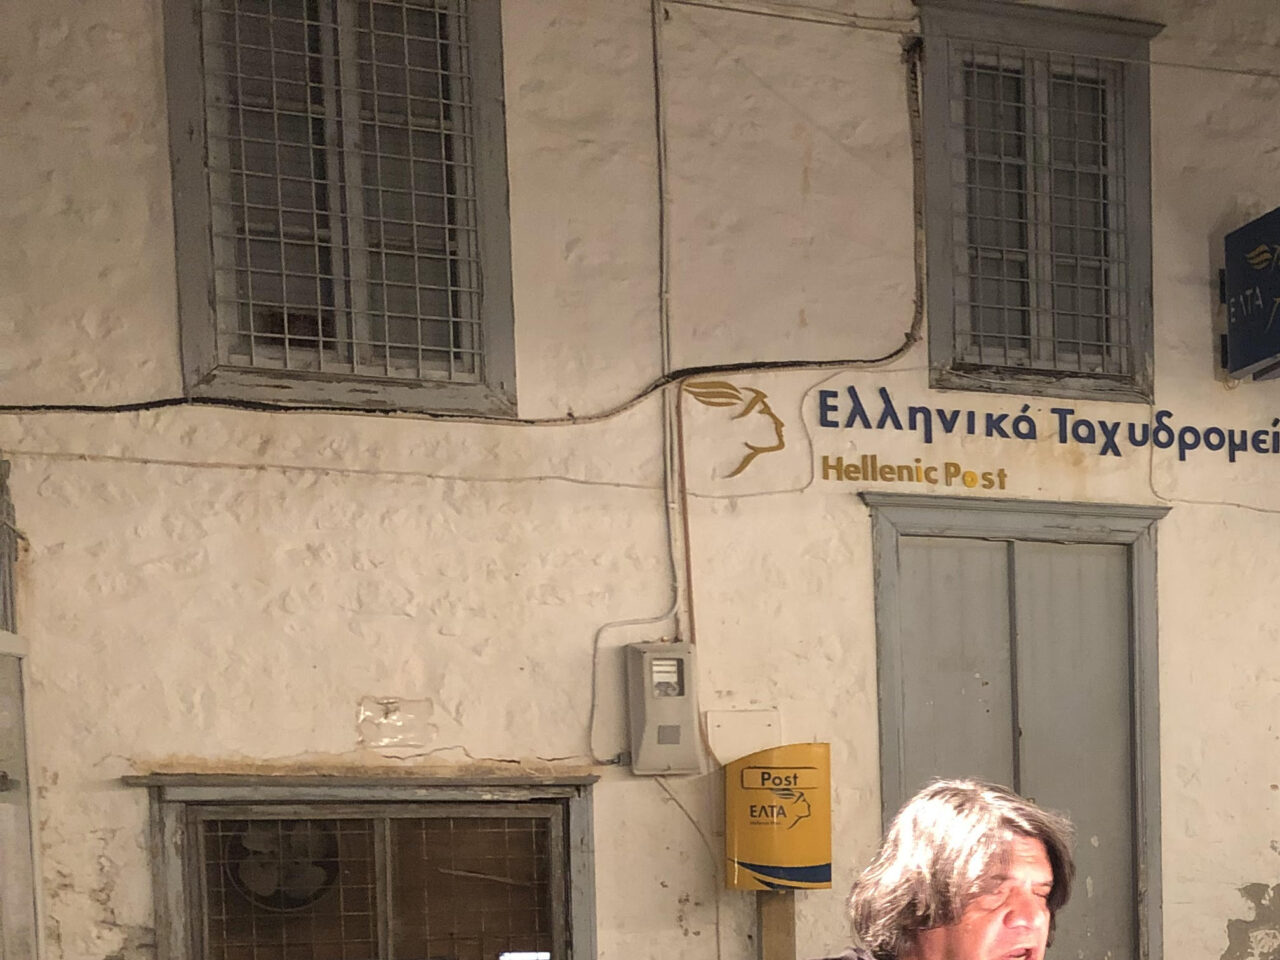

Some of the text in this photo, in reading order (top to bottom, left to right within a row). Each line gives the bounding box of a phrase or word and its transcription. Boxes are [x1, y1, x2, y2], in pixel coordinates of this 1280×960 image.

[818, 385, 1037, 444] Ελληνικά
[821, 455, 1009, 491] Hellenic Post
[760, 771, 799, 787] Post
[749, 804, 787, 818] ΕΛΤΑ
